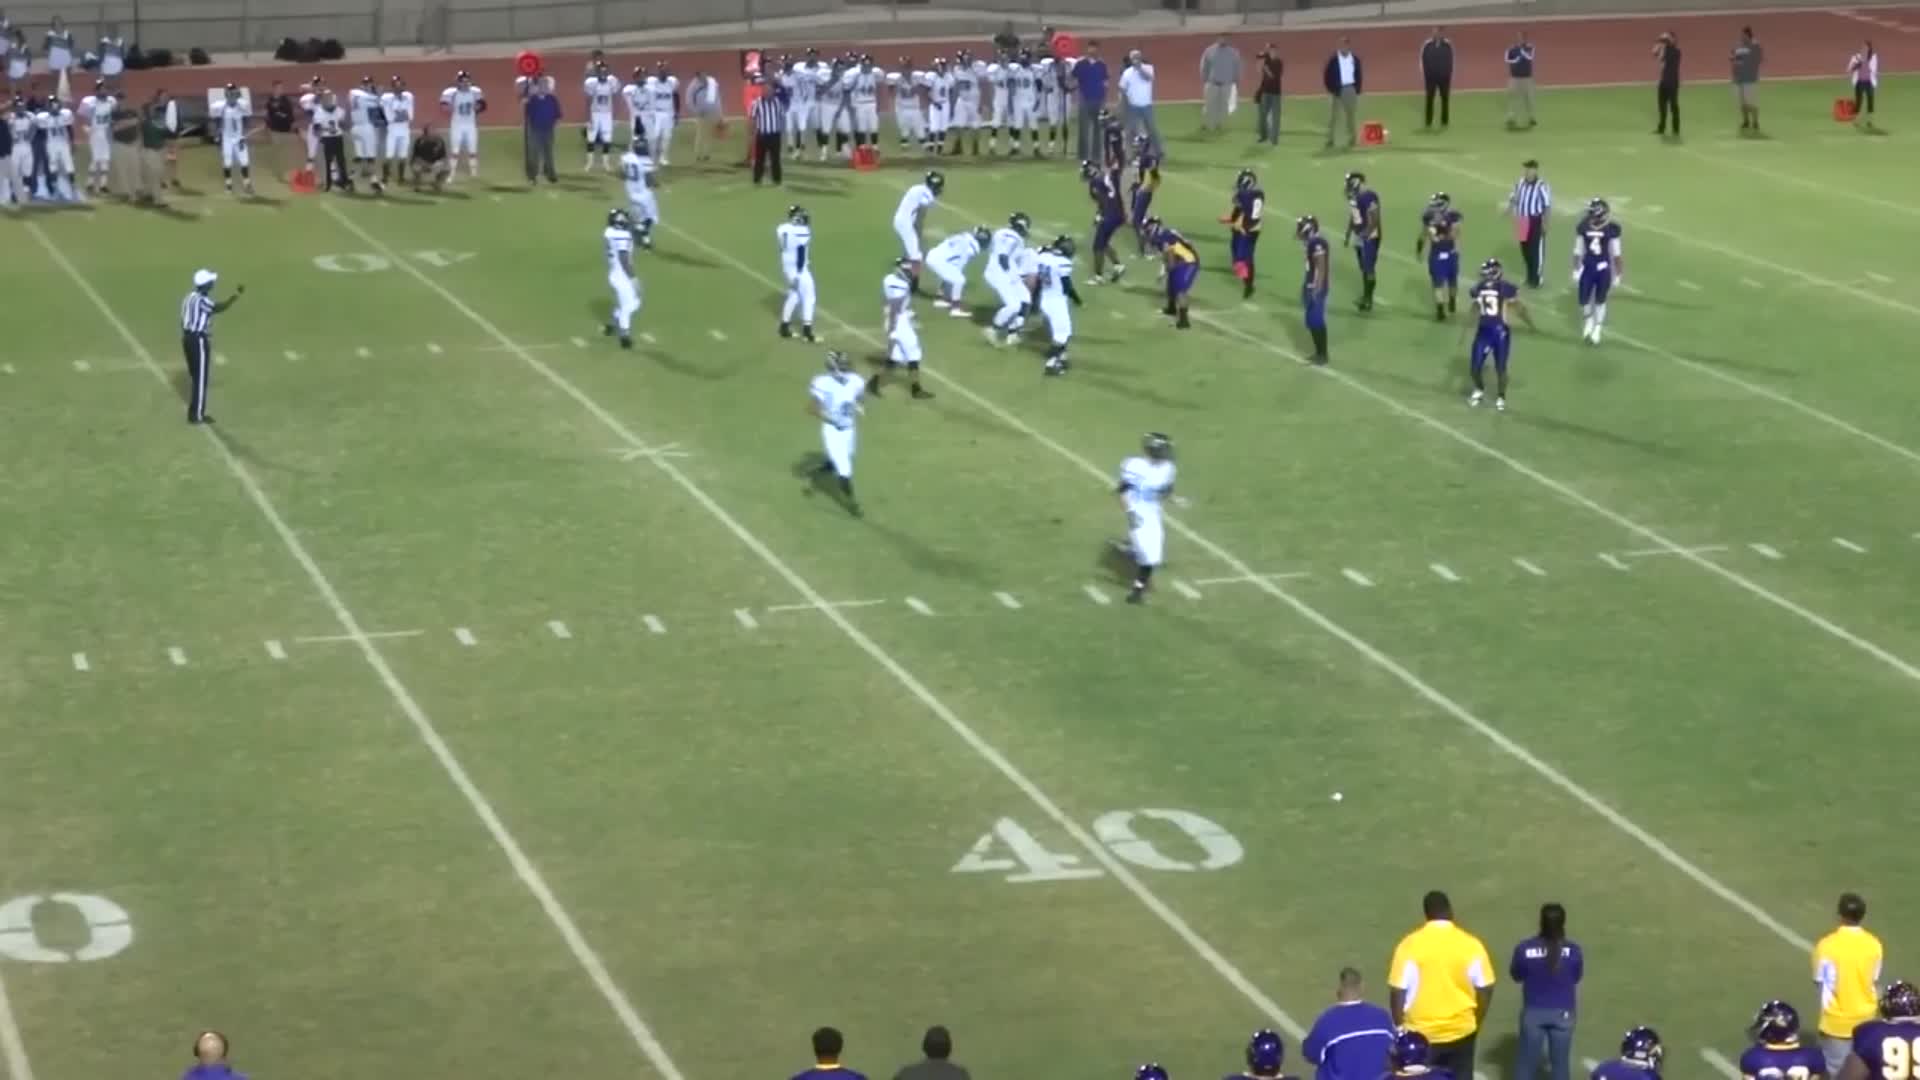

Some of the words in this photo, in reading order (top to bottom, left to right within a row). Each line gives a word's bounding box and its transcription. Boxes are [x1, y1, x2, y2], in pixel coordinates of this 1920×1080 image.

[1589, 237, 1602, 255] 4
[1477, 295, 1499, 316] 13
[949, 807, 1245, 883] 40
